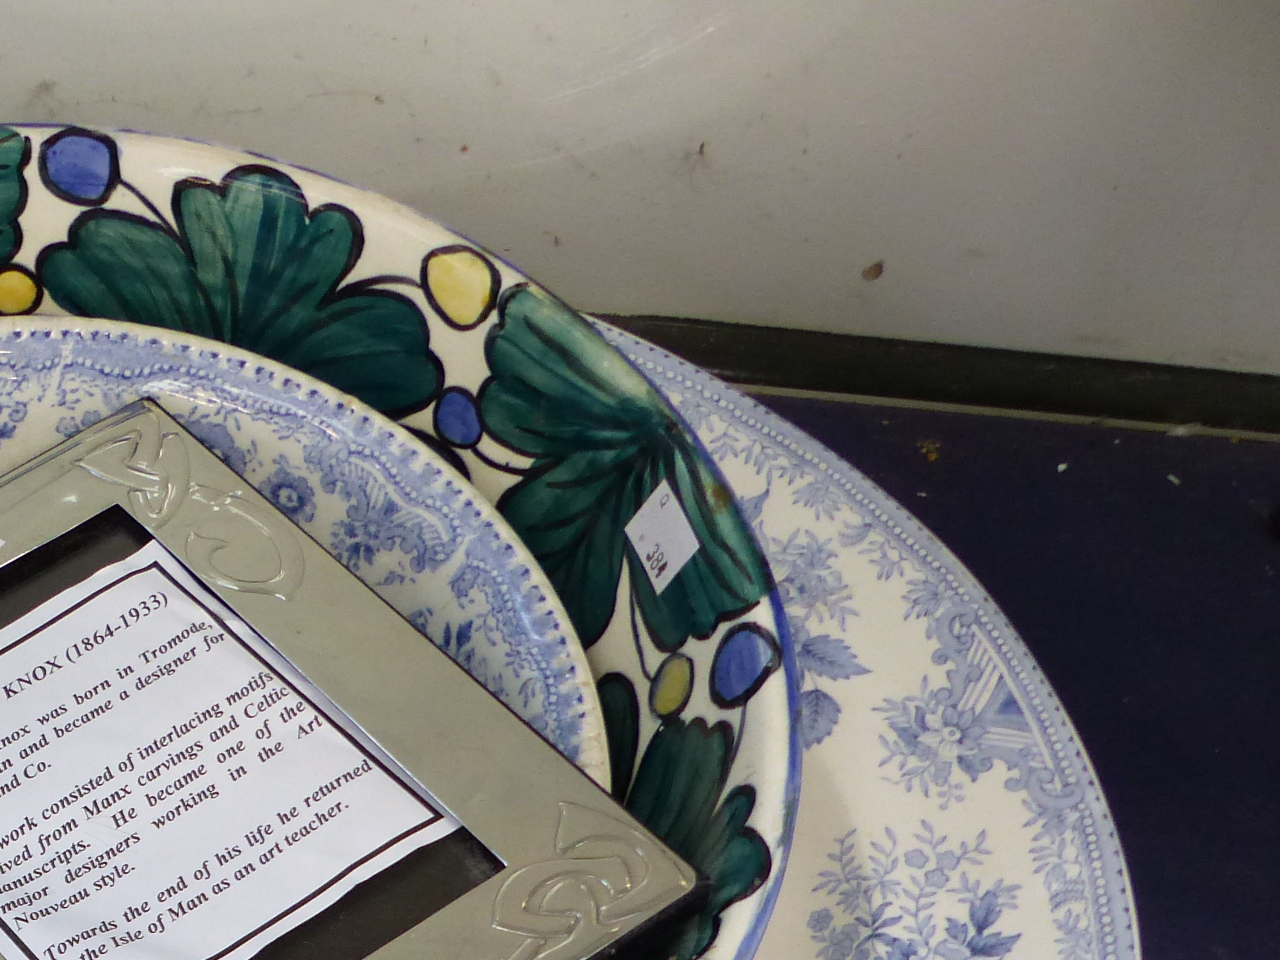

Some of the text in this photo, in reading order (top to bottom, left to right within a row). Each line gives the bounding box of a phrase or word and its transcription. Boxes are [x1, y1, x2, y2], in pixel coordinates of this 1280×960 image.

[2, 655, 64, 700] KNOX
[65, 591, 168, 664] (1864-1933)
[19, 733, 50, 760] and
[52, 699, 114, 739] became
[119, 690, 131, 701] a
[135, 646, 197, 691] designer
[203, 633, 225, 653] for
[35, 703, 68, 726] was
[72, 679, 112, 706] born
[115, 665, 135, 680] in
[138, 621, 213, 665] Tromode,
[23, 761, 52, 779] Co.
[37, 818, 79, 856] from
[82, 784, 132, 821] Manx
[137, 740, 204, 787] carvings
[209, 714, 240, 743] and
[243, 689, 288, 719] Celtic
[41, 766, 115, 821] consisted
[118, 752, 135, 773] of
[136, 703, 224, 761] interlacing
[225, 672, 273, 707] motifs
[110, 807, 138, 829] He
[144, 764, 208, 807] became
[216, 740, 246, 764] one
[255, 718, 272, 740] of
[279, 702, 304, 724] the
[0, 716, 322, 914] major designers working in the Art
[110, 930, 145, 948] Isle
[147, 913, 165, 934] of
[166, 892, 209, 922] Man
[211, 878, 231, 895] as
[233, 862, 256, 881] an
[258, 841, 284, 865] art
[283, 801, 349, 847] teacher.
[122, 901, 151, 923] the
[157, 875, 189, 903] end
[193, 860, 211, 881] of
[214, 845, 242, 867] his
[244, 824, 274, 847] life
[276, 806, 300, 825] he
[303, 758, 373, 808] returned
[13, 863, 136, 931] Nouveau style.
